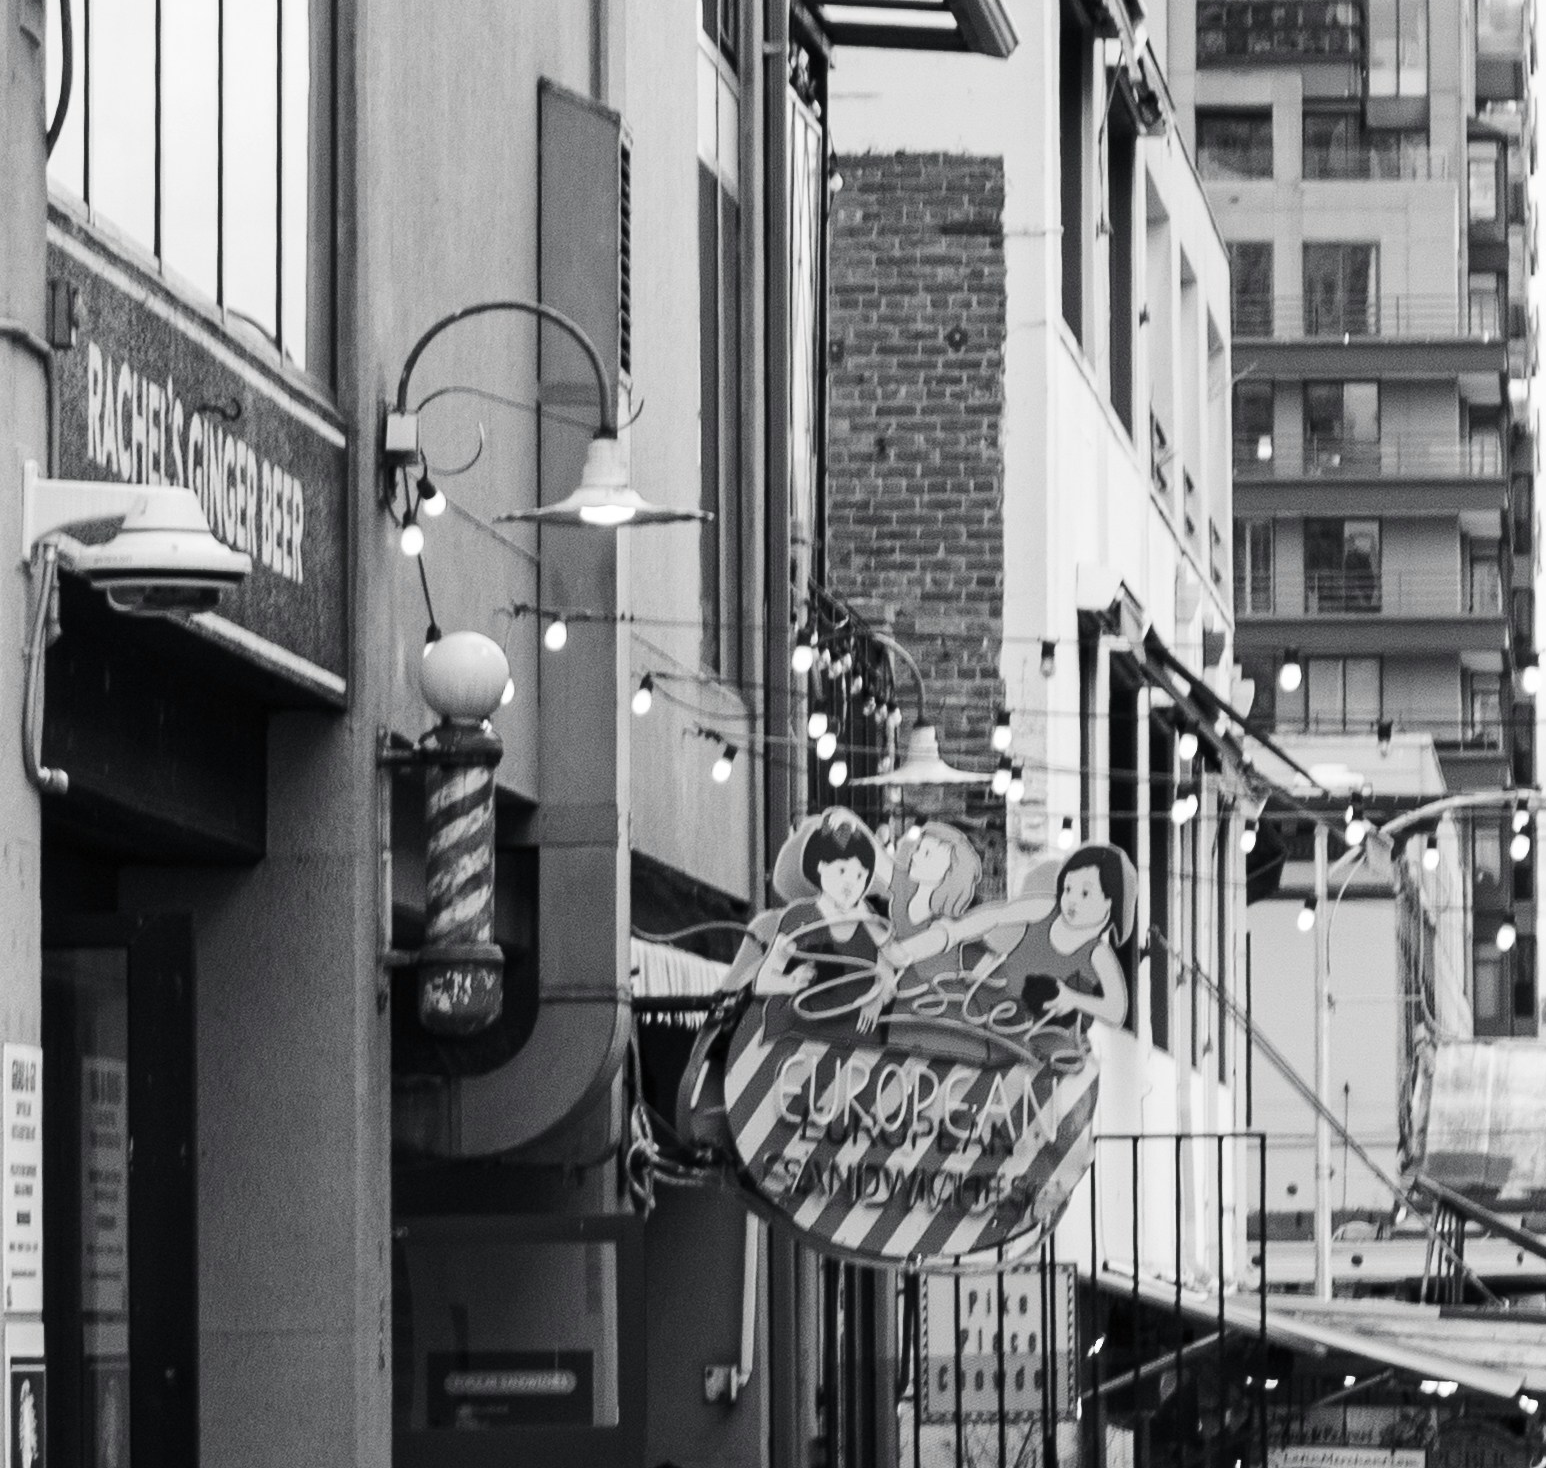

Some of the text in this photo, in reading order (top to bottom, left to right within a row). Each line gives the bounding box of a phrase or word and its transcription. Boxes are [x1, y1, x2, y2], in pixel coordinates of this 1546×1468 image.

[87, 340, 303, 584] RACHEL'S GINGER BEER
[777, 1052, 1059, 1144] EUROPEAN
